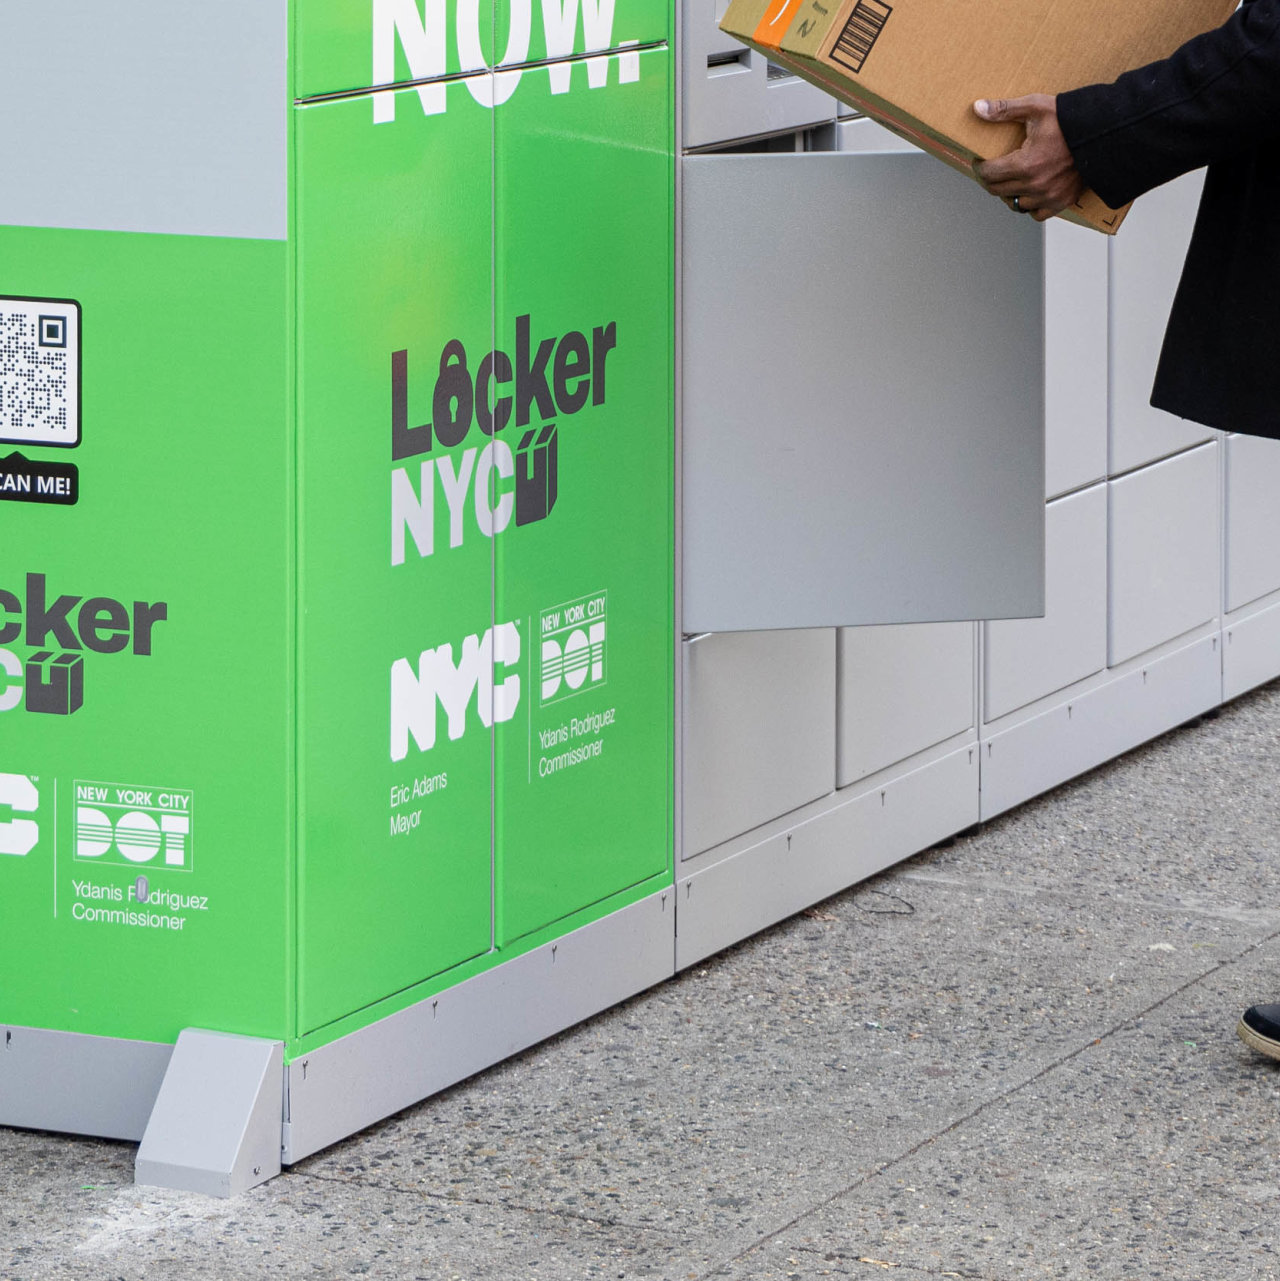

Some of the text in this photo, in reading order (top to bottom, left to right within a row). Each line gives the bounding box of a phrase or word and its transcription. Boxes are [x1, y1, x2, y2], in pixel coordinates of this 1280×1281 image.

[391, 314, 616, 461] Locker
[37, 475, 71, 496] ME!
[391, 439, 515, 567] NYC
[542, 596, 605, 632] NEW YORK CITY
[542, 621, 606, 700] DOT
[390, 621, 521, 762] NYC
[539, 707, 615, 751] Ydanis Rodriguez
[539, 739, 603, 777] Commissioner
[77, 786, 189, 809] NEW YORK CITY
[390, 771, 448, 807] Eric Adams
[77, 806, 189, 866] DOT
[390, 808, 422, 836] Mayor
[72, 879, 123, 901] Ydanis
[72, 902, 186, 930] Commissioner
